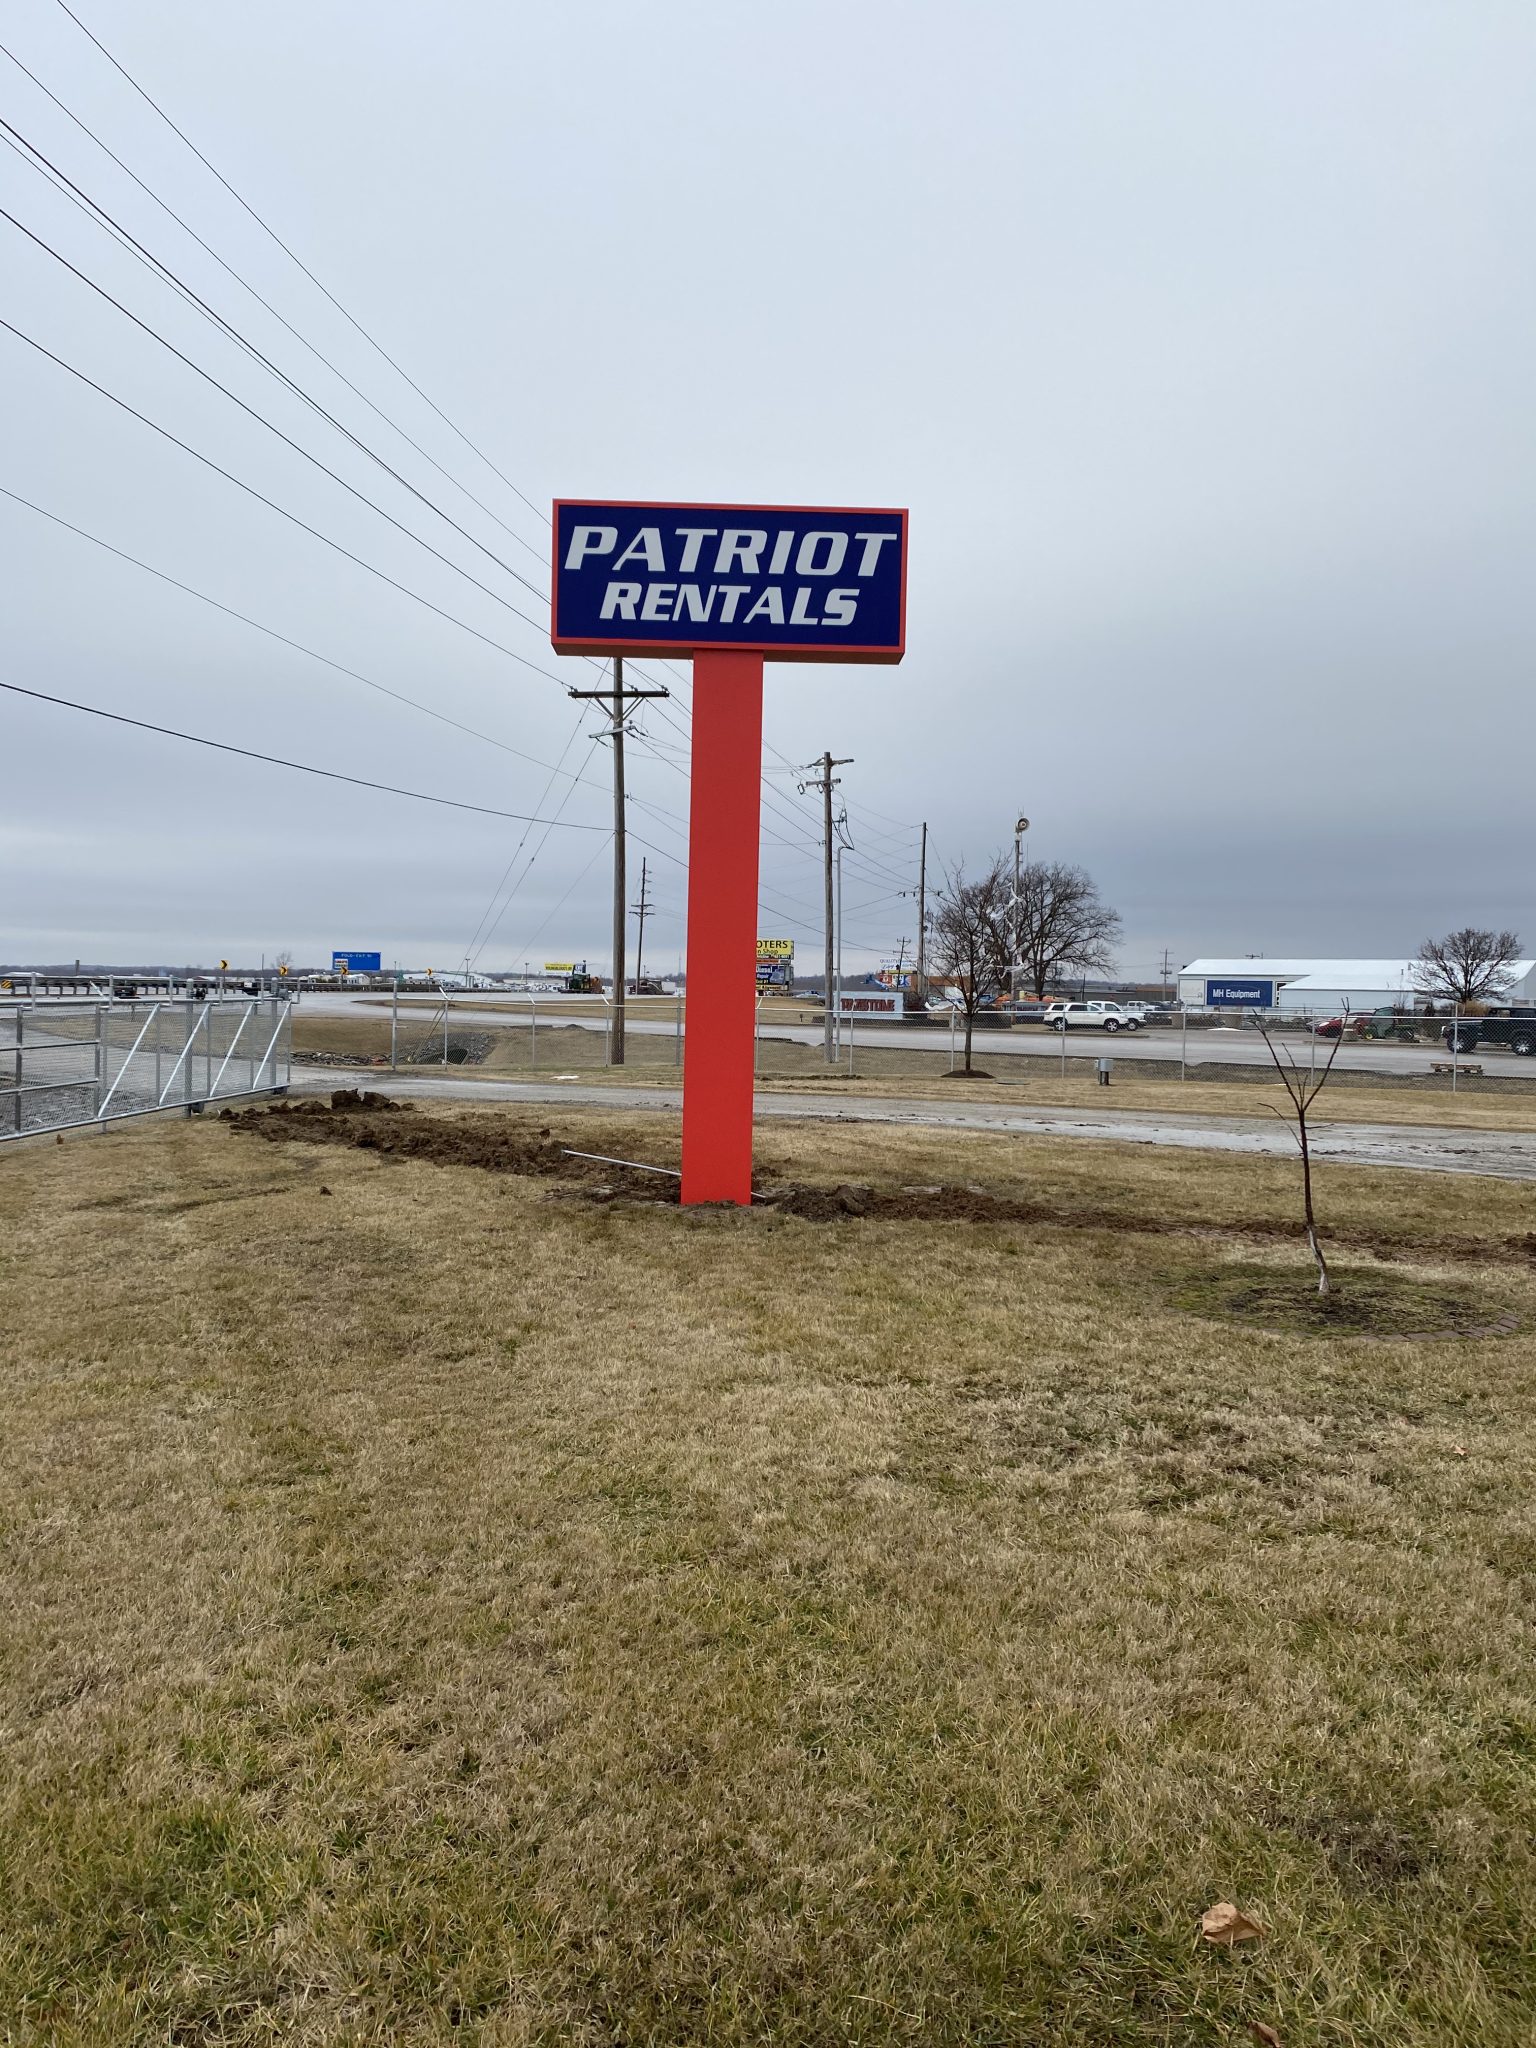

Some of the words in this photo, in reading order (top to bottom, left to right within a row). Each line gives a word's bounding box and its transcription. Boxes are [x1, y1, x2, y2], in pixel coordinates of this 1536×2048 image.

[564, 525, 898, 577] PATRIOT
[599, 581, 861, 627] RENTALS
[1212, 988, 1224, 998] MH
[1225, 989, 1261, 999] Equipment
